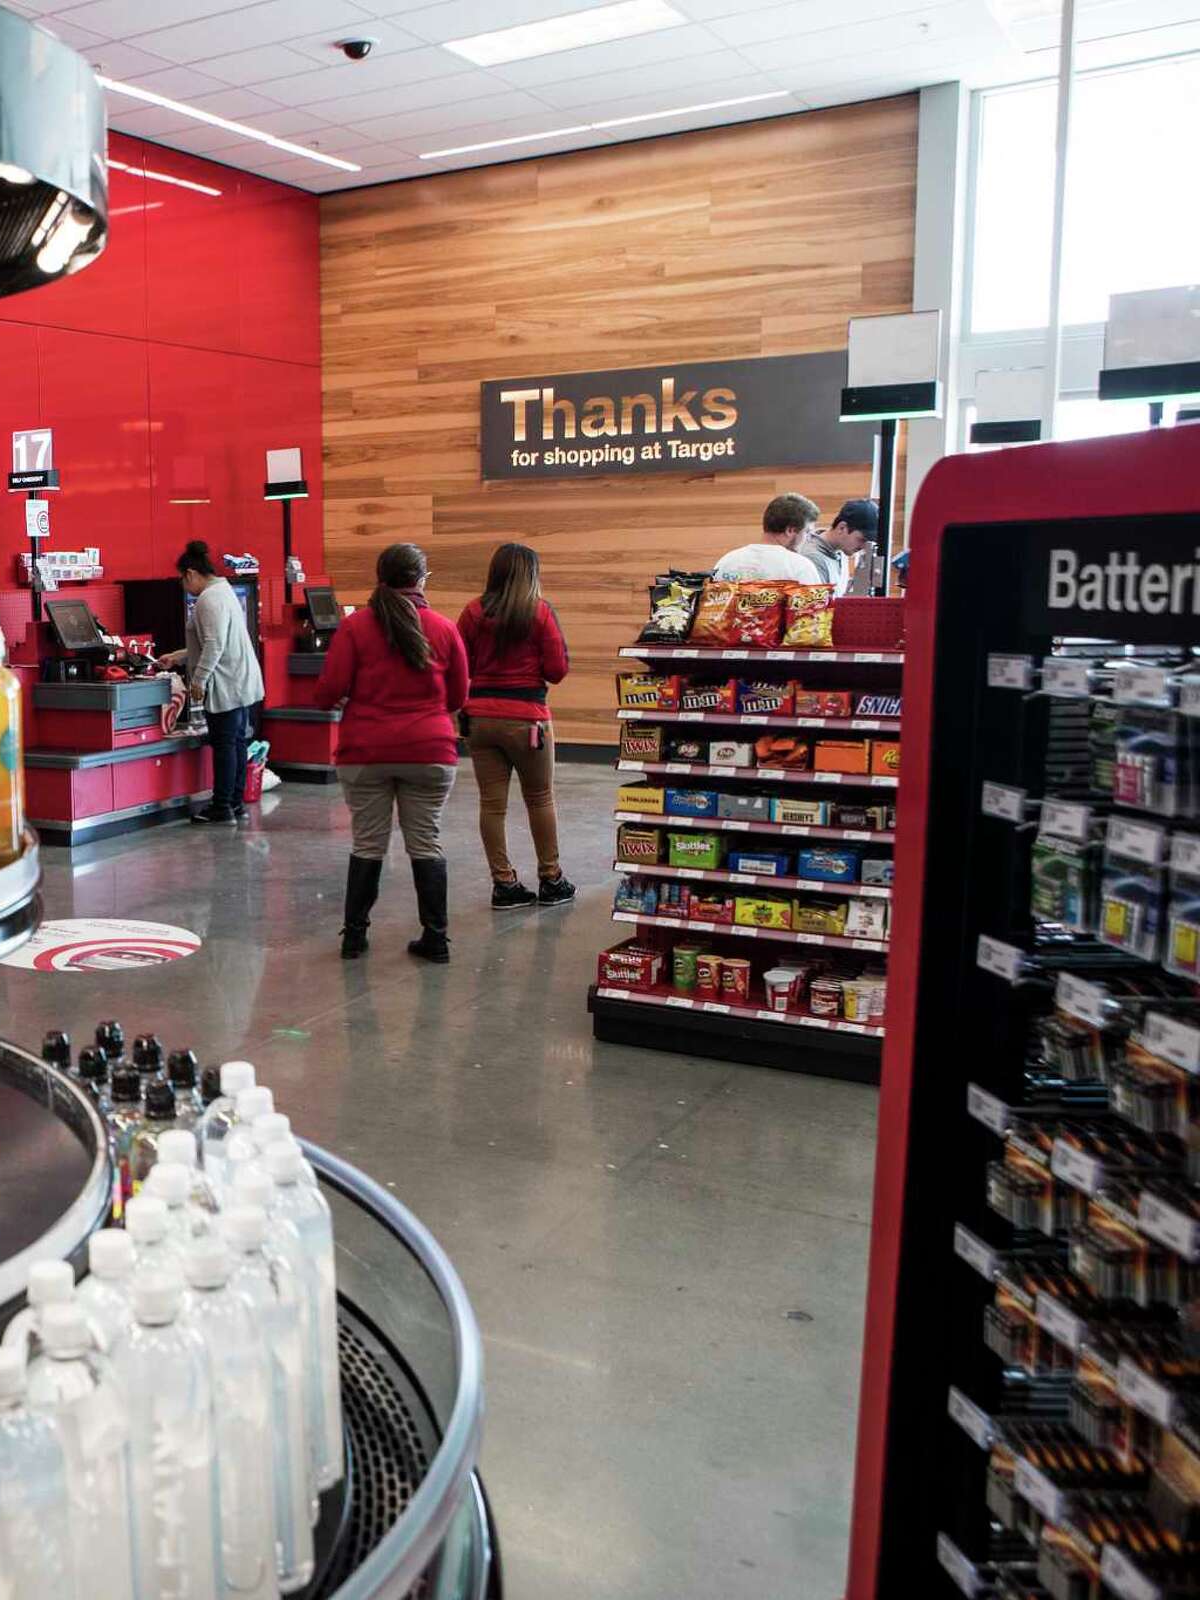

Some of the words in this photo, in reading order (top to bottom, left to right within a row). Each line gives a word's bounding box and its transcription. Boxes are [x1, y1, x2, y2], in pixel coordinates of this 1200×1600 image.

[500, 378, 738, 441] Thanks
[14, 432, 51, 472] 17
[511, 449, 539, 466] for
[543, 443, 635, 467] shopping
[641, 440, 661, 460] at
[667, 437, 735, 461] Target
[622, 841, 657, 857] TWIX
